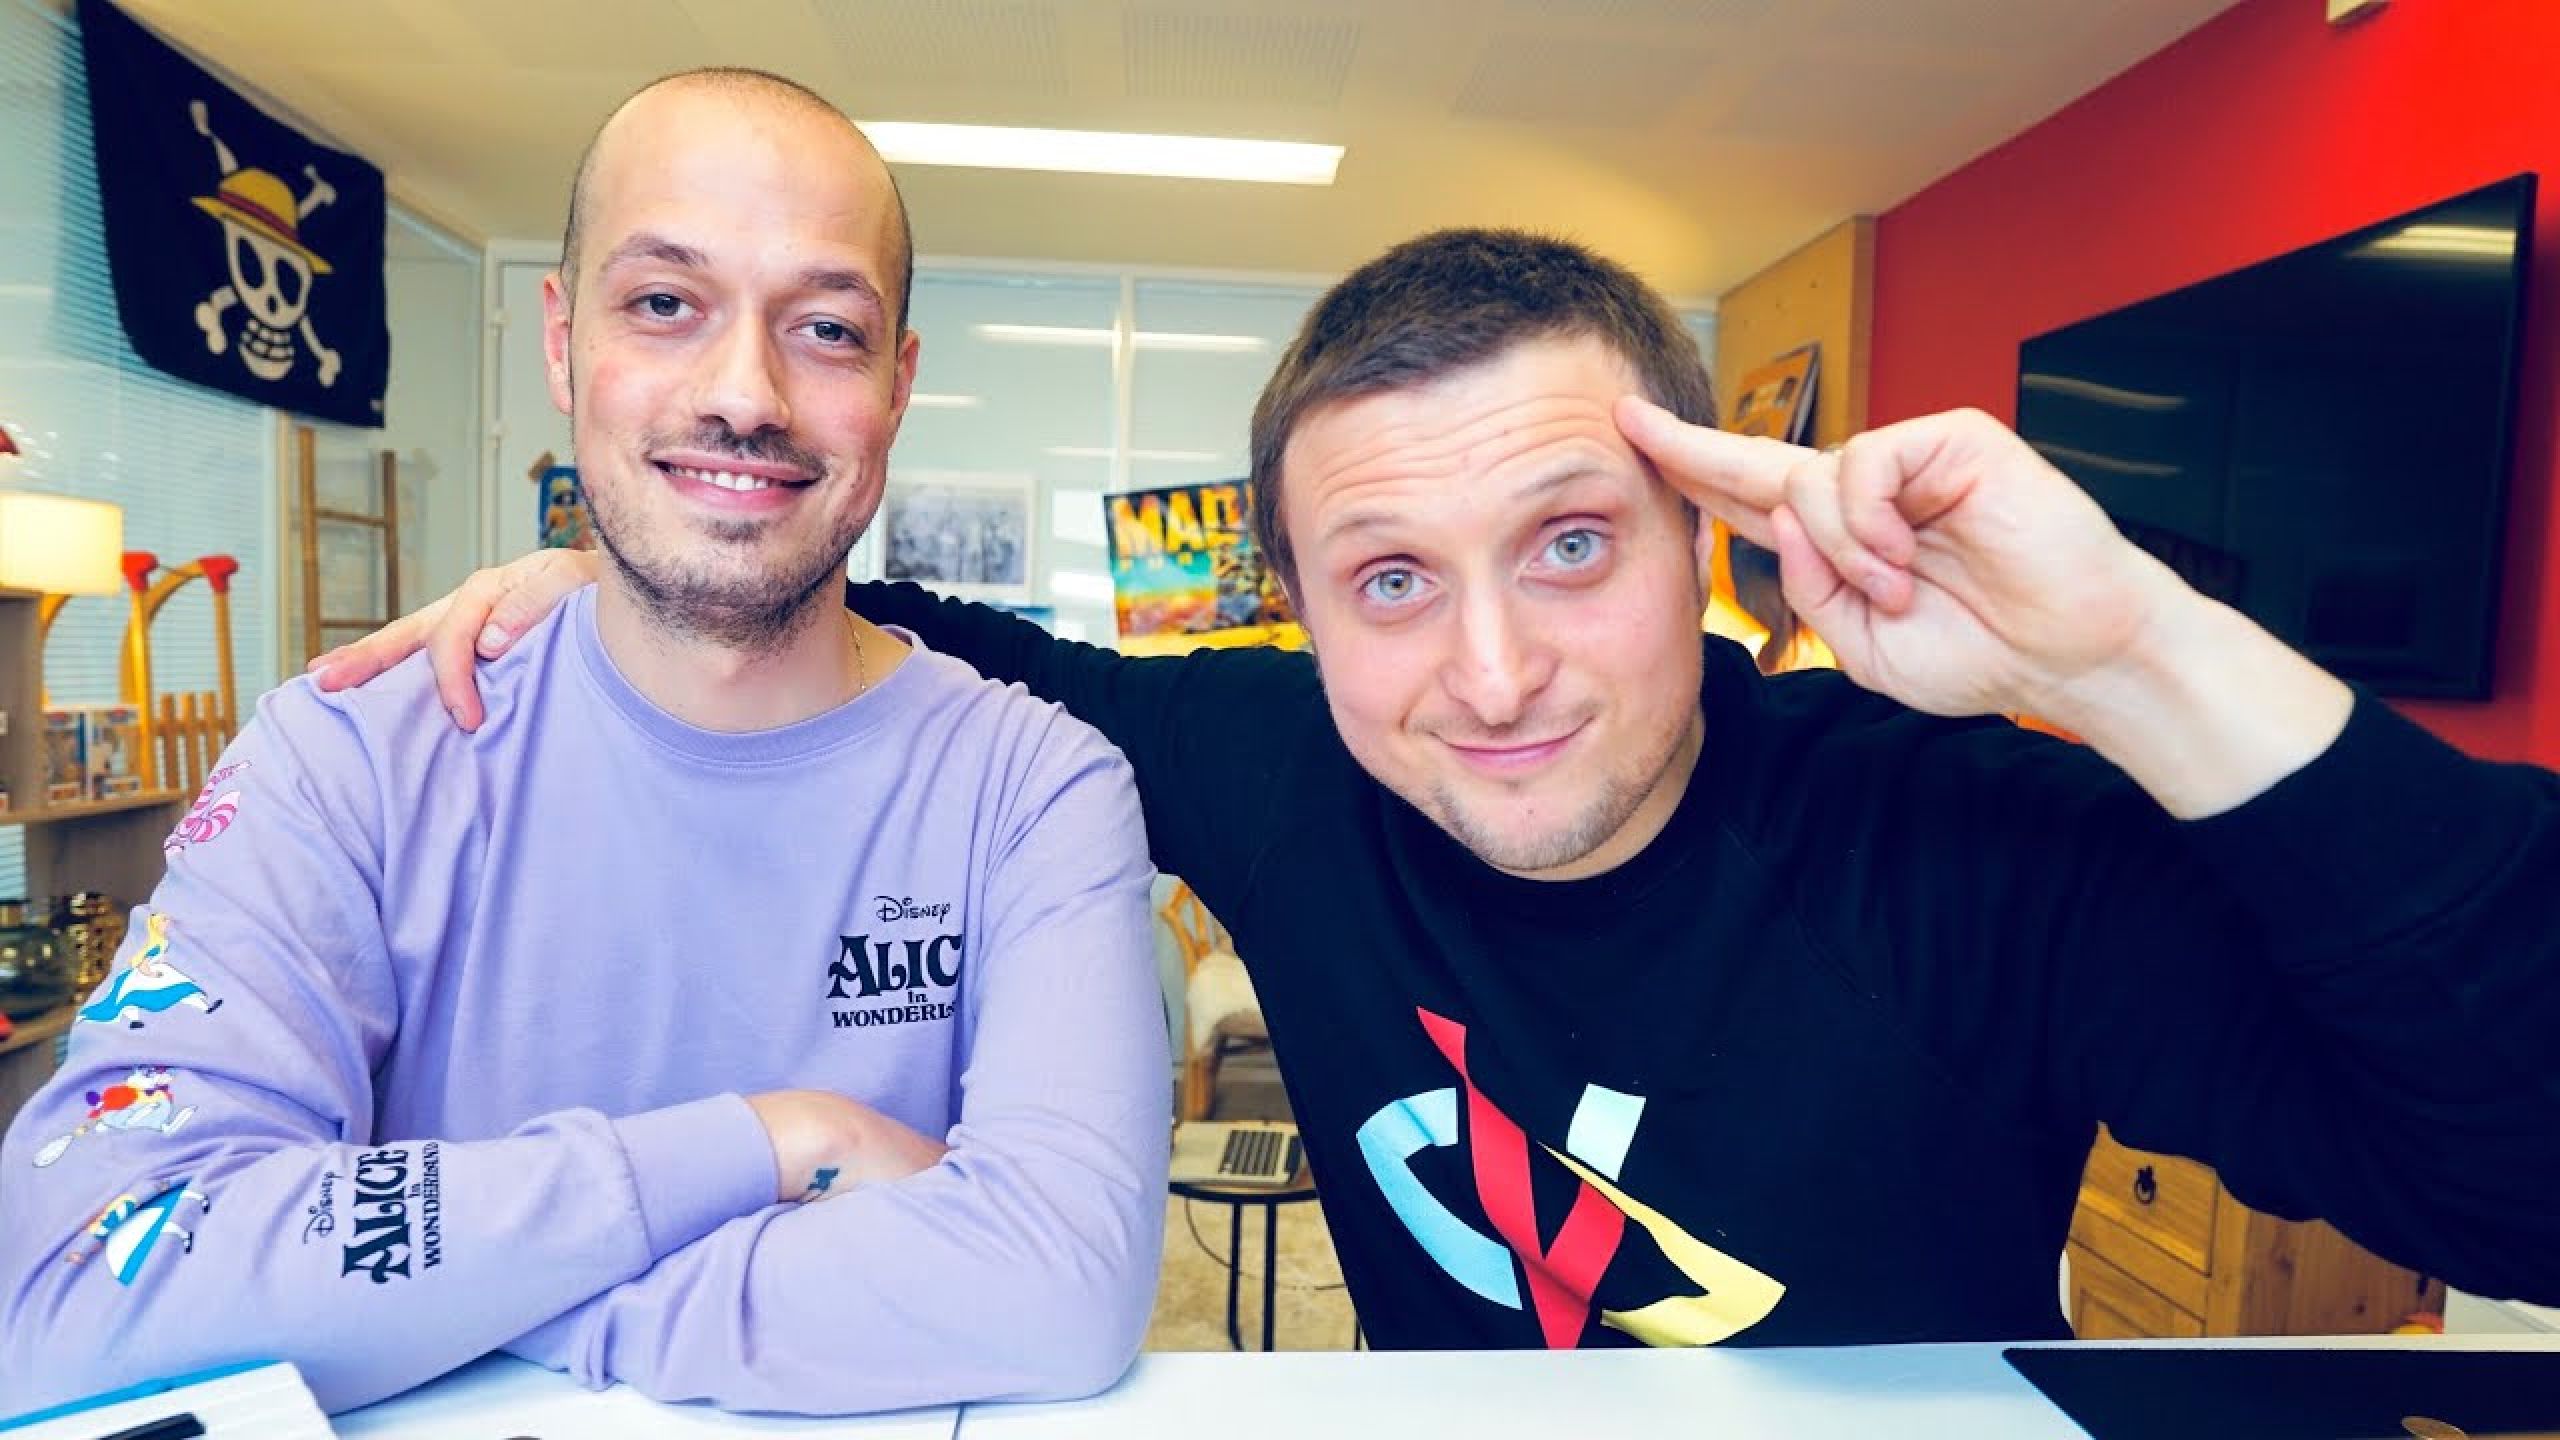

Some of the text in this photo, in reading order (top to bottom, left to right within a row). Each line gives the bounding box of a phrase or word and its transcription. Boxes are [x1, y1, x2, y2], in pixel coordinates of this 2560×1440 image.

[826, 933, 964, 999] ALIC
[832, 1001, 955, 1029] WONDERL
[340, 1149, 412, 1284] ALICE
[422, 1141, 442, 1271] WONDERLAND
